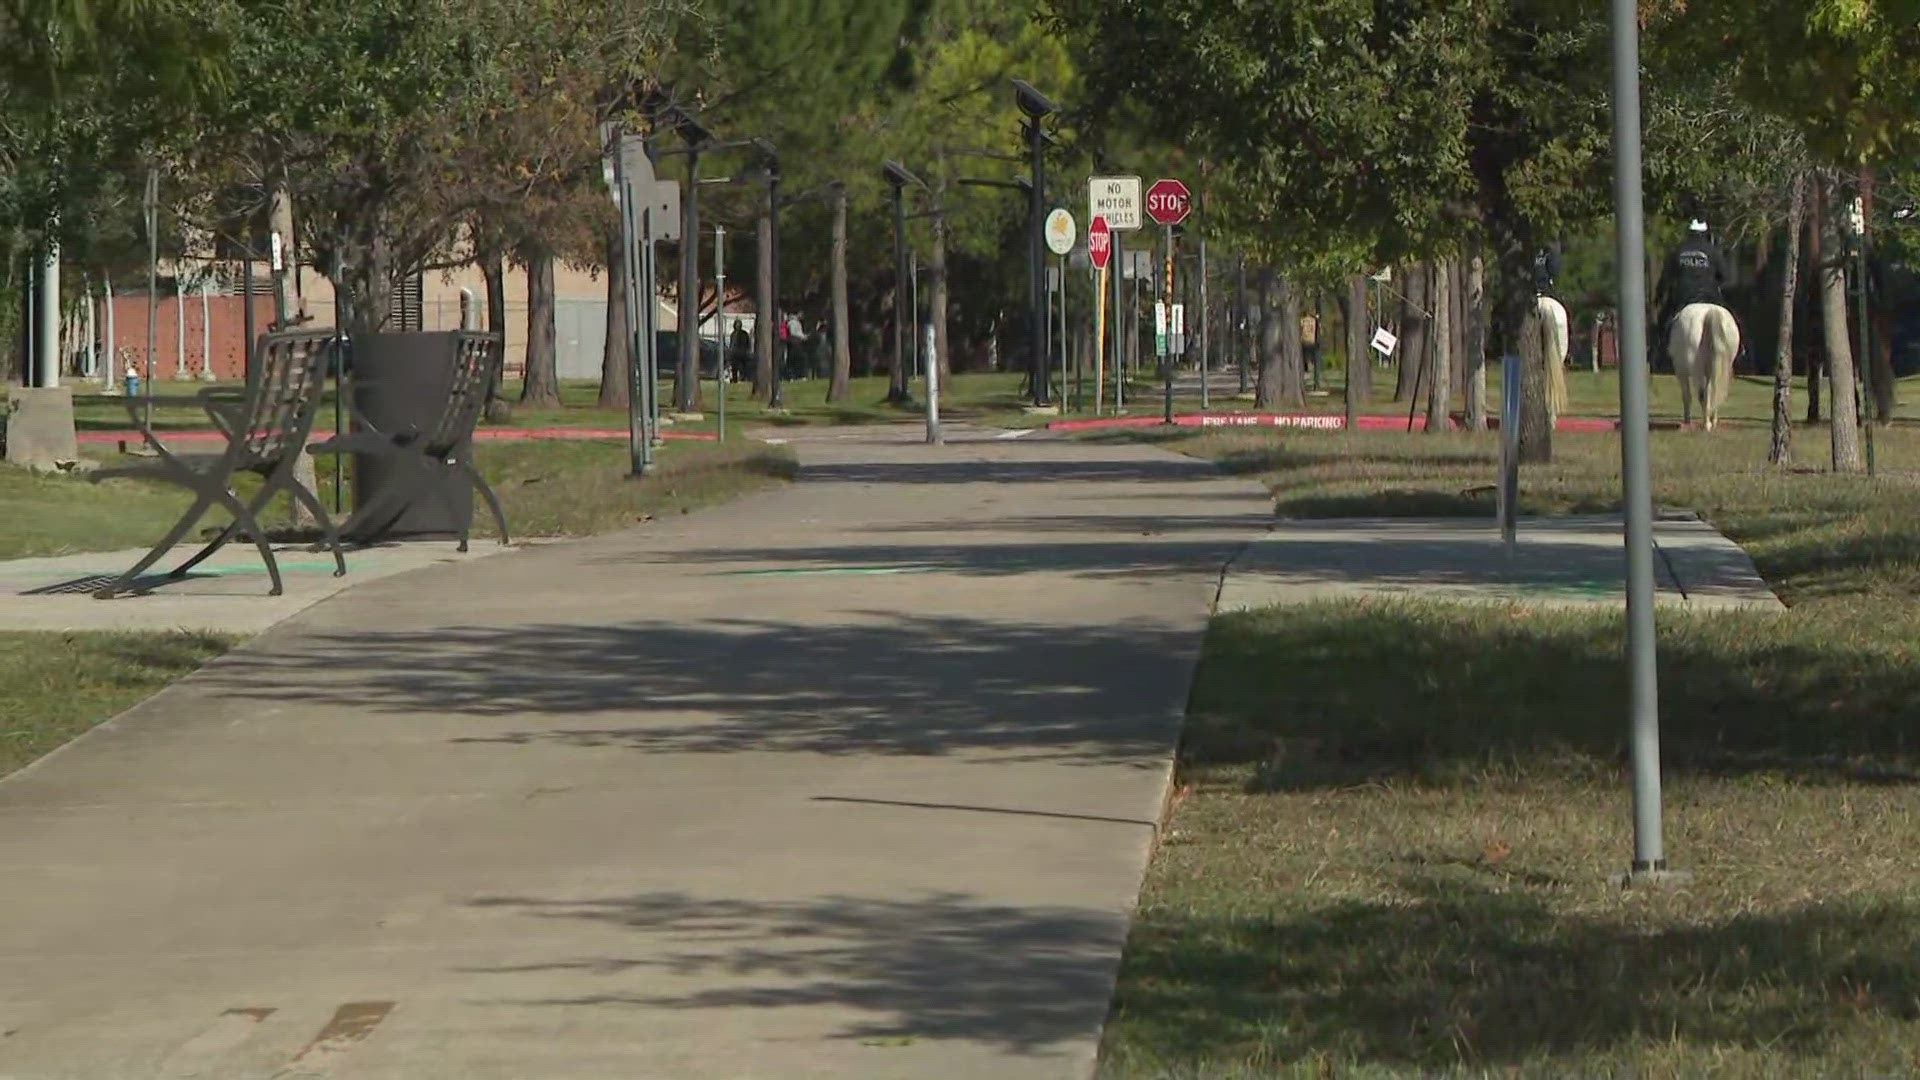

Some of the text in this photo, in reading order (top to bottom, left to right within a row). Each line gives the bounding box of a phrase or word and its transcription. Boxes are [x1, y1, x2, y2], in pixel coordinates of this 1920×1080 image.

[1107, 183, 1121, 194] NO
[1097, 198, 1132, 209] MOTOR
[1149, 194, 1187, 213] STOP
[1097, 212, 1135, 225] HICLES
[1090, 232, 1109, 252] STOP
[1274, 416, 1291, 427] NO
[1292, 416, 1341, 429] PARKING
